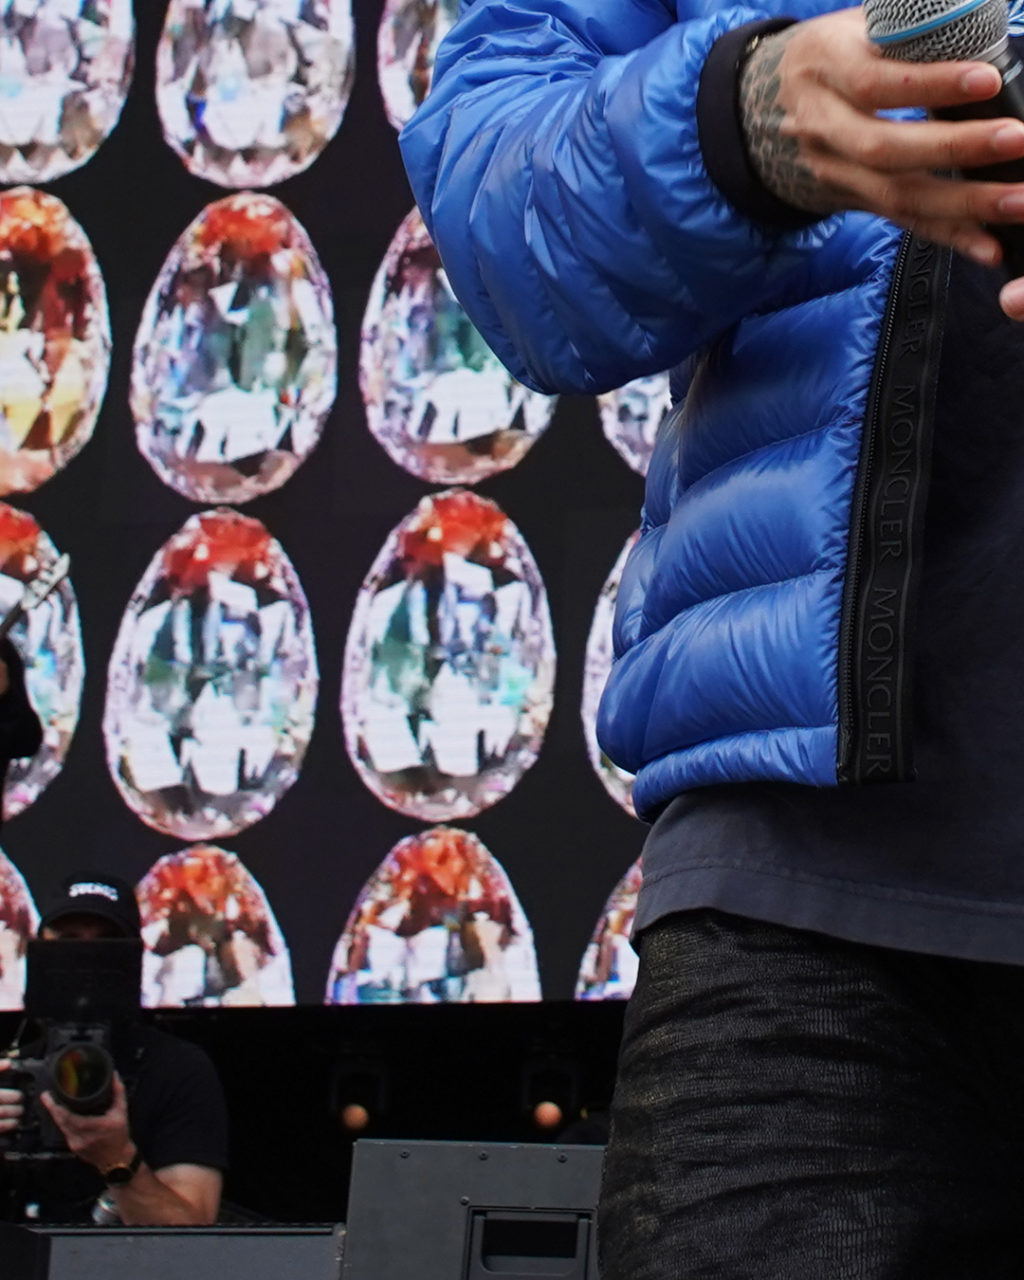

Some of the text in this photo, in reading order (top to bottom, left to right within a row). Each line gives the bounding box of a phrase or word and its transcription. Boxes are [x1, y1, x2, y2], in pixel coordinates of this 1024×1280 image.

[899, 239, 936, 360] ONCLER
[879, 384, 916, 561] MONCLER
[865, 587, 900, 776] MONCLER
